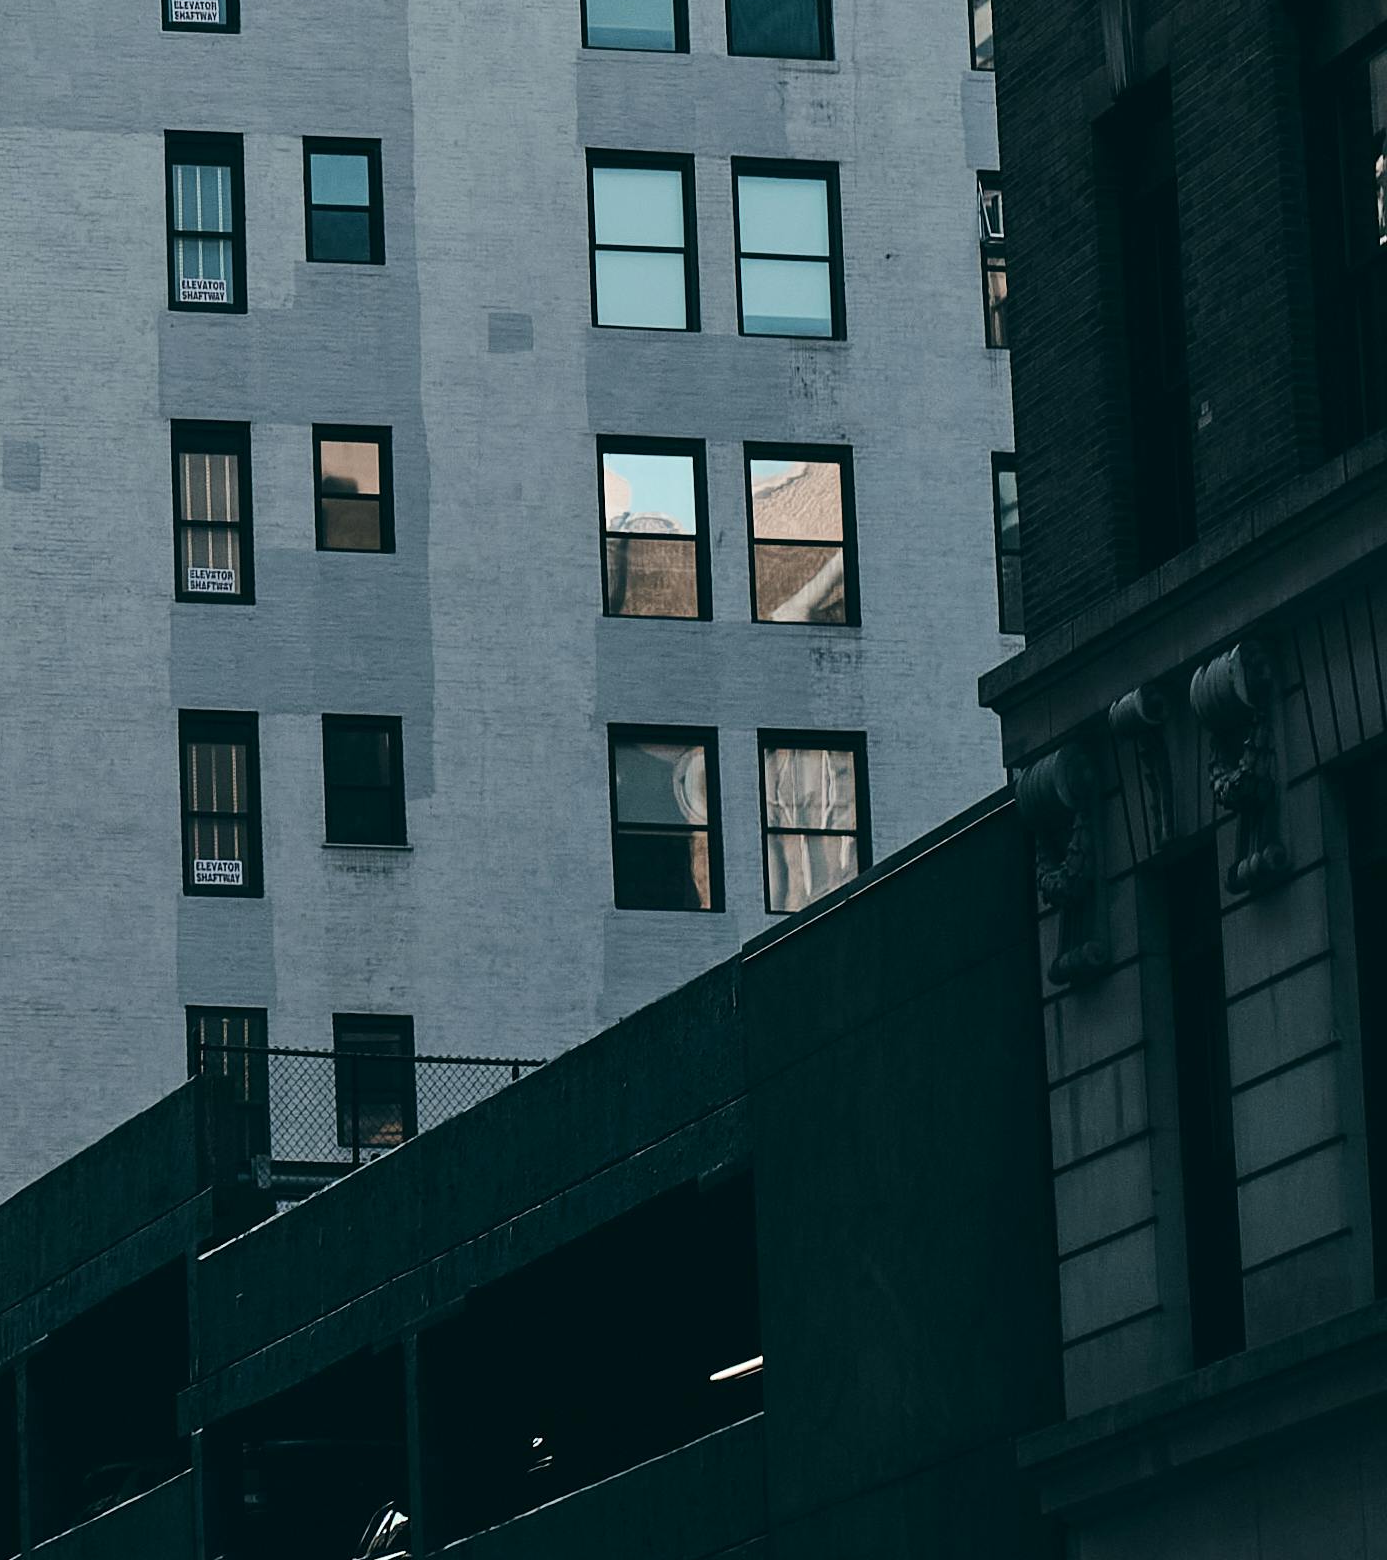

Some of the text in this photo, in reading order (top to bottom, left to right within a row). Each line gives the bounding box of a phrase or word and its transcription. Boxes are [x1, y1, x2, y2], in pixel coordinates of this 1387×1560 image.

[173, 0, 217, 11] ELEVATOR
[174, 11, 218, 22] SHAFTWAY
[181, 280, 225, 291] ELEVATOR
[182, 291, 225, 301] SHAFTWAY
[189, 569, 234, 580] ELEVATOR
[190, 580, 234, 591] SHAFTWAY
[195, 861, 240, 872] ELEVATOR
[196, 873, 241, 883] SHAFTWAY
